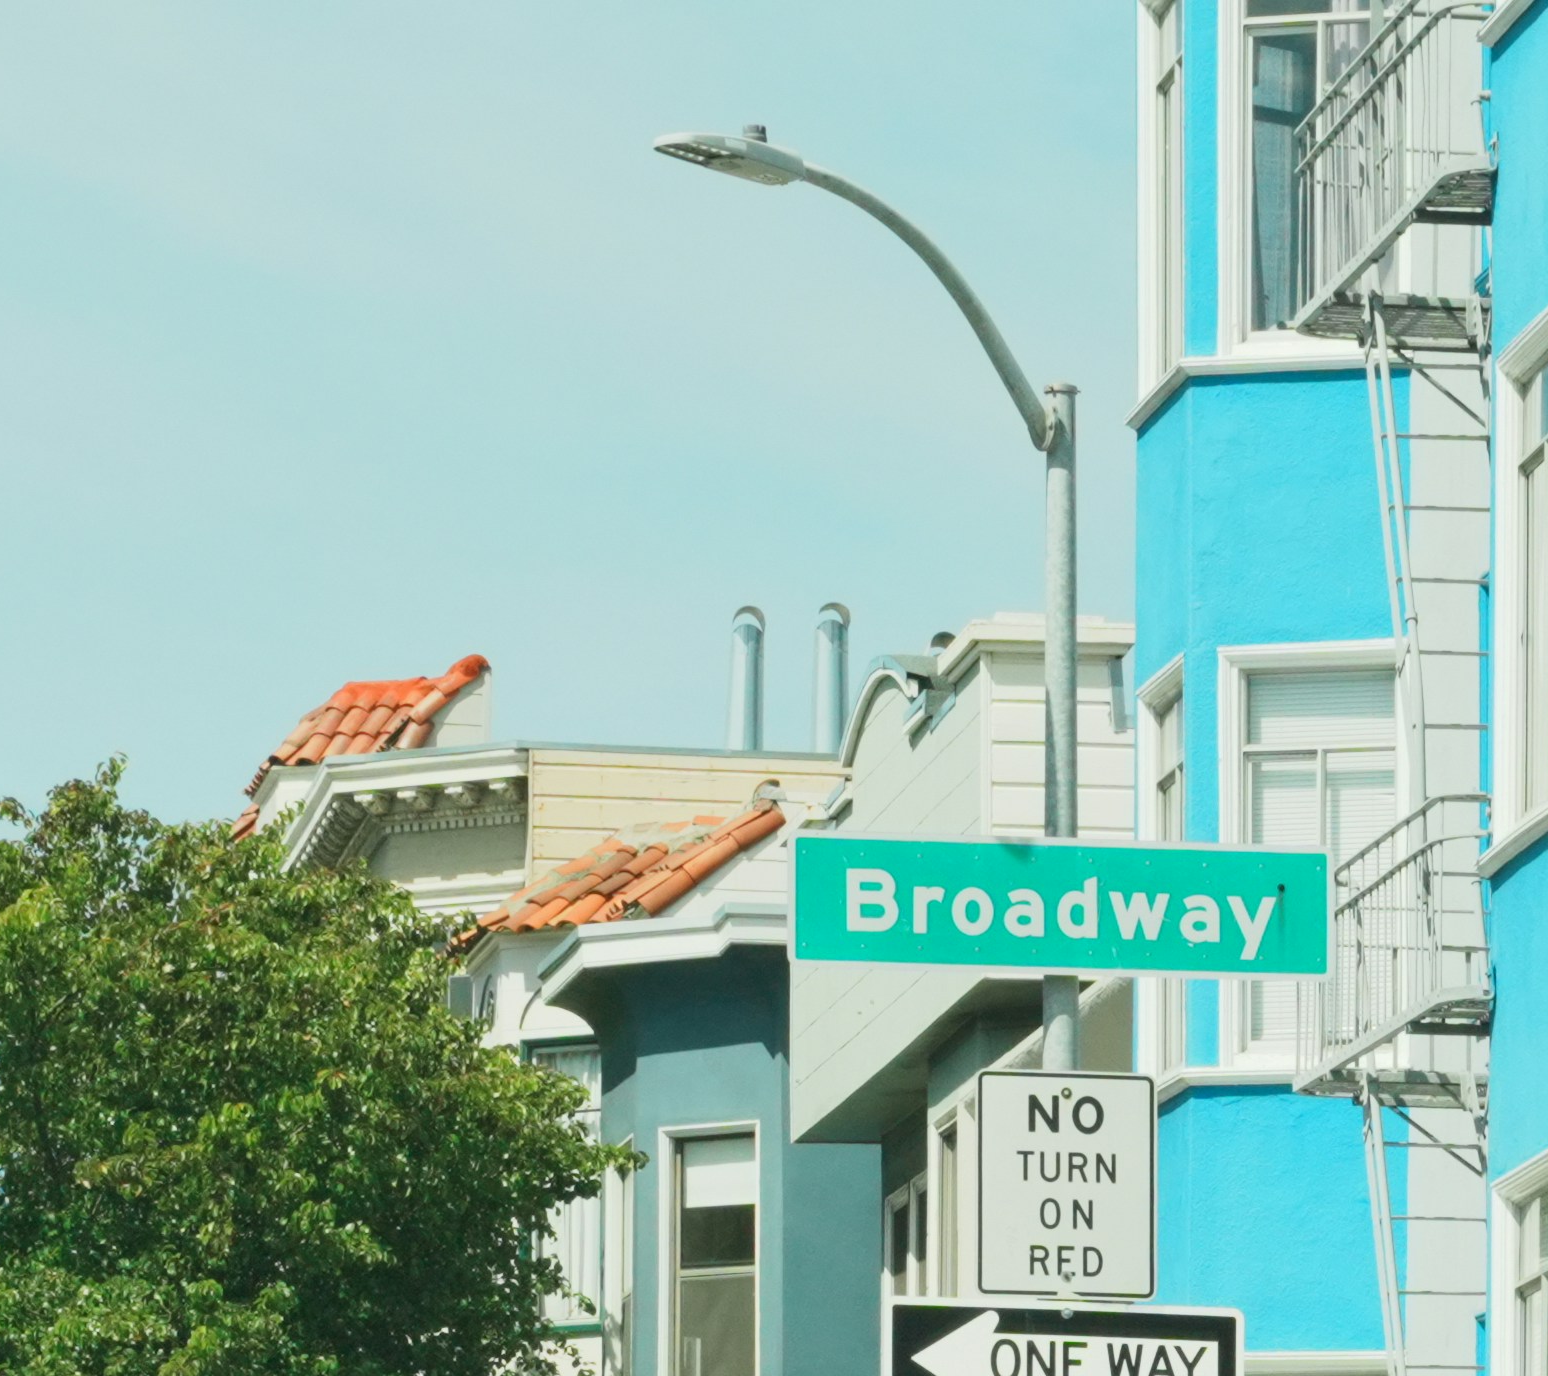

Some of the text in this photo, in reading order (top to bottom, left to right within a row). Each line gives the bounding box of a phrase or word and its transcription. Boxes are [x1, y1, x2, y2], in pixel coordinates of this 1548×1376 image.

[844, 867, 1277, 961] Broadway
[1028, 1094, 1105, 1134] NO
[1016, 1150, 1117, 1184] TURN
[1039, 1198, 1095, 1230] ON
[1028, 1245, 1104, 1279] RED
